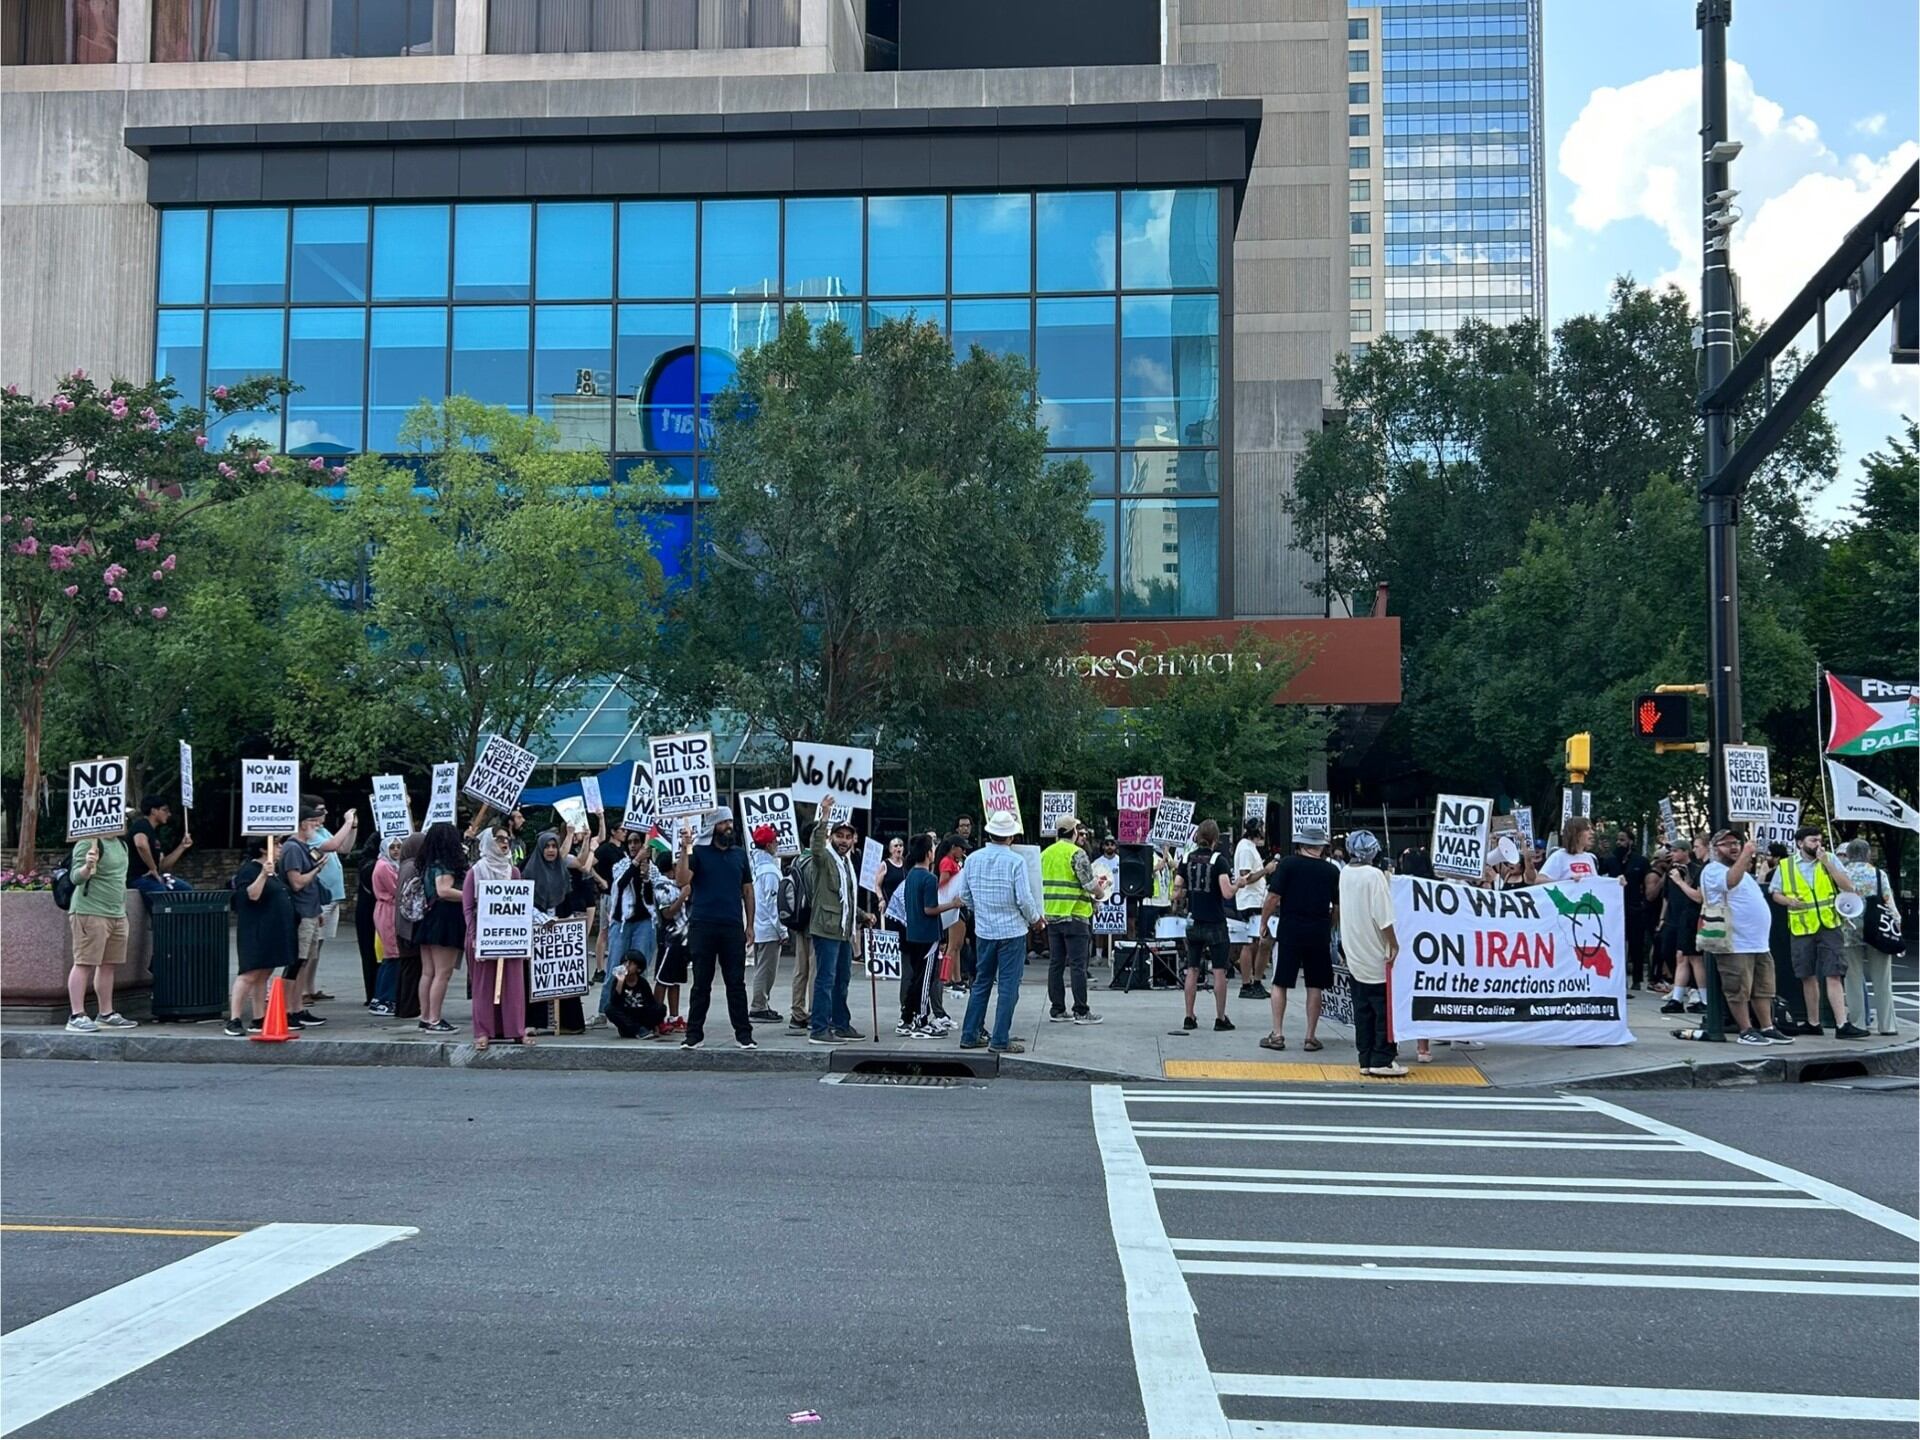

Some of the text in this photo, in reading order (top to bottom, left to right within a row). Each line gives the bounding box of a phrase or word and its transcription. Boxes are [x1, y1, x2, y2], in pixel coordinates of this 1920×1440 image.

[490, 737, 536, 764] MONEY FOR
[653, 739, 708, 758] END
[1728, 751, 1764, 760] MONEY FOR
[486, 744, 532, 772] PEOPLE'S
[655, 754, 710, 776] ALL U.S.
[1728, 760, 1766, 770] PEOPLE'S
[246, 765, 292, 776] NO WAR
[480, 752, 528, 783] NEEDS
[74, 762, 123, 790] NO
[474, 765, 520, 796] NOT WAR
[634, 764, 652, 788] N
[792, 754, 872, 796] No War
[1729, 770, 1767, 784] NEEDS
[251, 782, 288, 794] IRAN!
[379, 782, 400, 791] HANDS
[657, 777, 685, 798] AID
[689, 774, 711, 794] TO
[988, 780, 1006, 795] NO
[1120, 778, 1162, 792] FUCK
[1730, 786, 1768, 798] NOT WAR
[73, 786, 122, 800] US-ISRAEL
[378, 793, 403, 802] OFF THE
[484, 784, 516, 807] IRAN
[658, 793, 712, 807] ISRAEL!
[1120, 792, 1162, 808] TRUMP
[73, 796, 122, 818] WAR
[249, 804, 294, 813] DEFEND
[744, 792, 790, 816] NO
[986, 795, 1016, 812] MORE
[1044, 805, 1074, 813] NEEDS
[1160, 804, 1190, 816] PEOPLE'S
[1161, 799, 1180, 808] MONEY
[1294, 800, 1327, 808] PEOPLE'S
[1746, 798, 1770, 812] IRAN
[1771, 802, 1797, 813] ND
[382, 810, 406, 820] MIDDLE
[627, 812, 643, 823] ON
[746, 812, 792, 824] US-ISRAEL
[1044, 814, 1056, 822] NOT
[1158, 812, 1190, 824] NEEDS
[1294, 806, 1327, 816] NEEDS
[1439, 802, 1484, 826] NO
[72, 814, 122, 829] ON IRAN!
[1777, 813, 1797, 826] U.S.
[1156, 822, 1171, 830] NOT
[1171, 824, 1188, 834] WAR
[1756, 826, 1795, 842] AD TO
[1165, 832, 1186, 842] IRAN
[1438, 834, 1481, 858] WAR
[1434, 854, 1450, 864] ON
[1452, 856, 1480, 870] IRAN!
[486, 885, 530, 896] NO WAR
[1412, 880, 1540, 919] NO WAR
[489, 903, 526, 916] IRAN!
[1095, 912, 1124, 923] WAR
[483, 928, 528, 937] DEFEND
[533, 924, 583, 936] MONEY FOR
[533, 932, 584, 946] PEOPLE'S
[534, 942, 584, 961] NEEDS
[1412, 930, 1554, 968] ON IRAN
[534, 959, 584, 976] NOT WAR
[868, 959, 900, 977] NO
[553, 971, 585, 987] IRAN
[1414, 970, 1591, 994] End the sanctions now!
[1433, 1002, 1615, 1017] ANSWER Coalition AnswerCoalition.org
